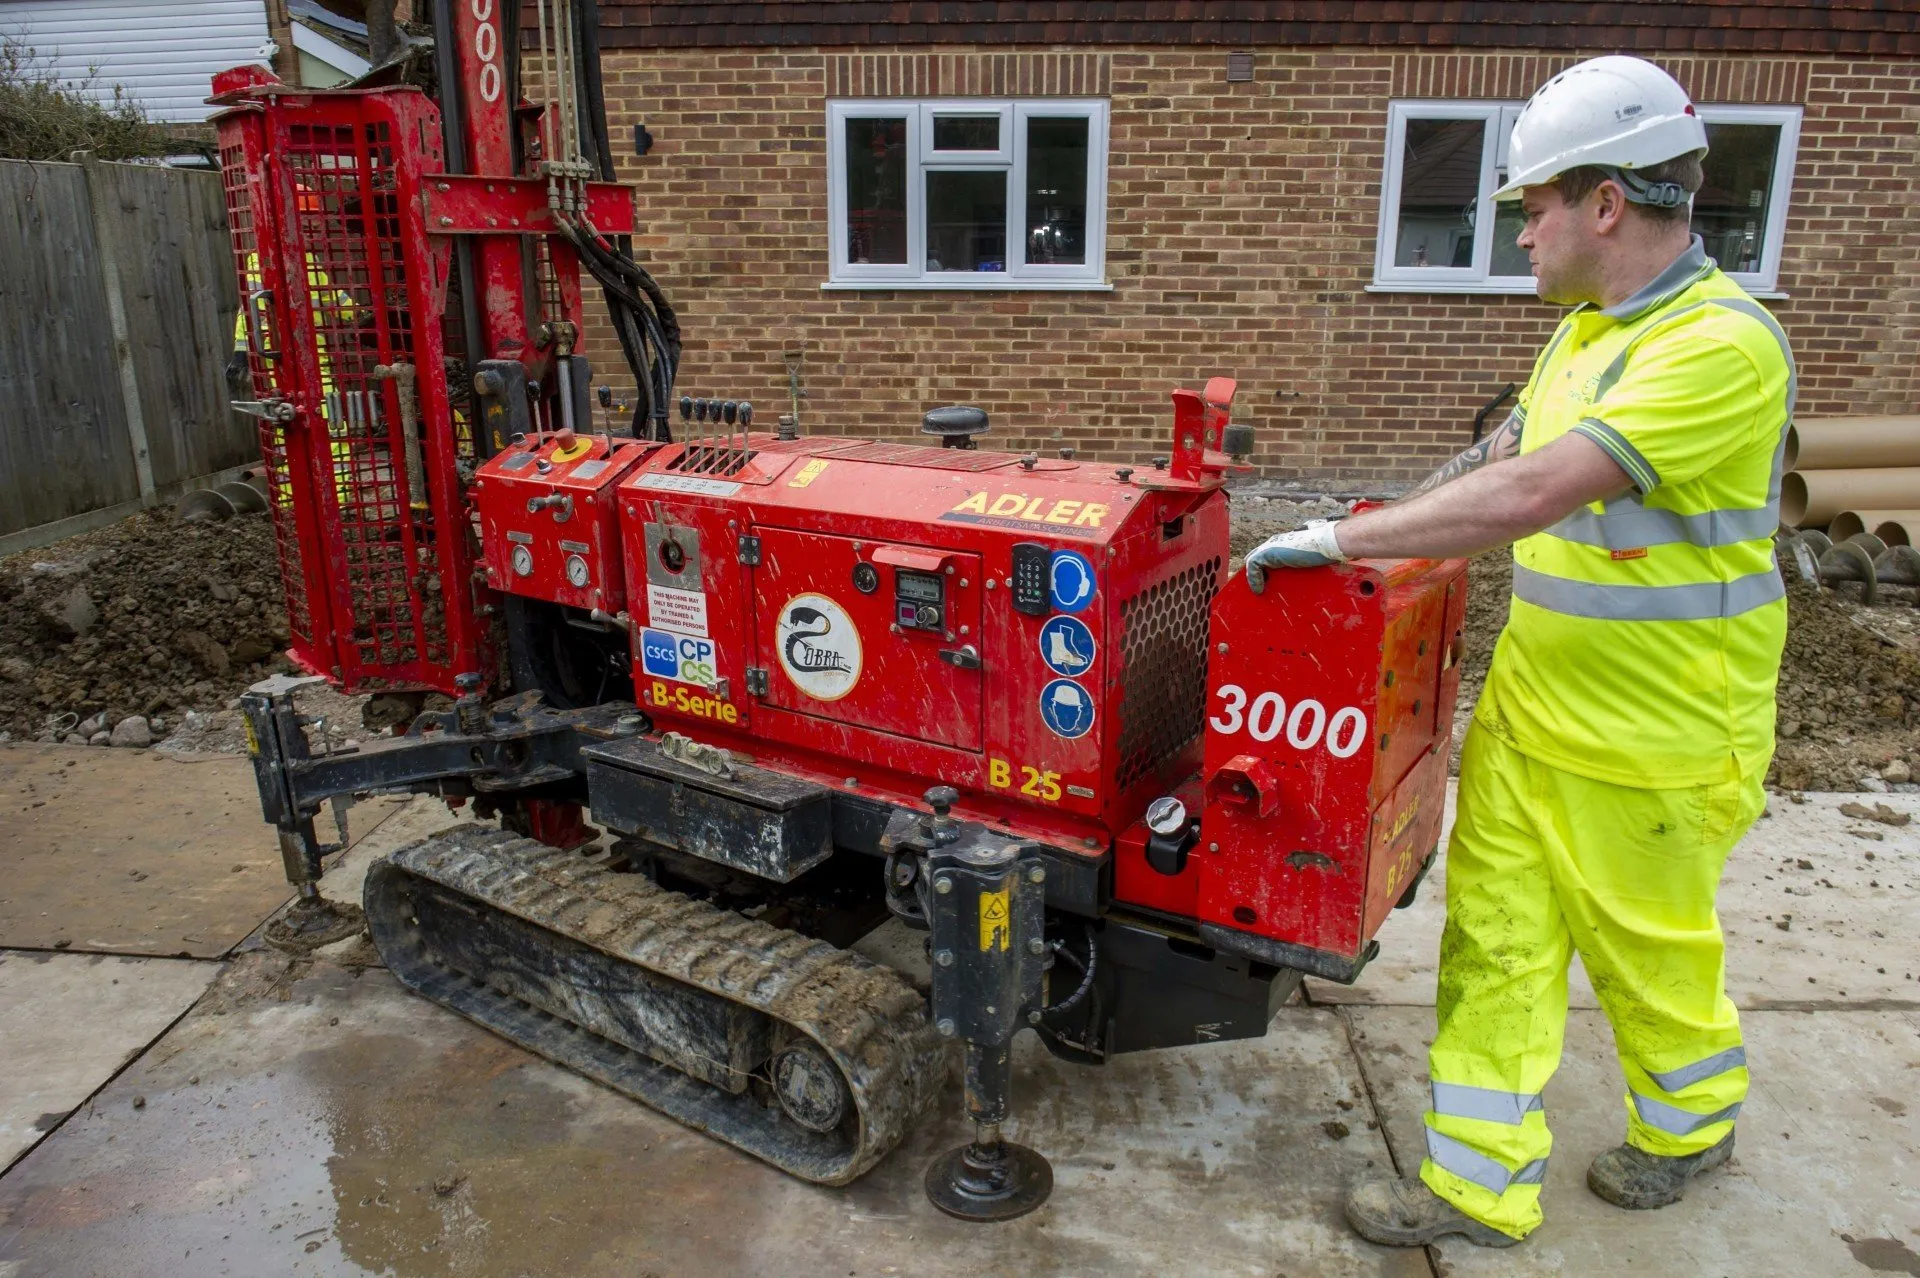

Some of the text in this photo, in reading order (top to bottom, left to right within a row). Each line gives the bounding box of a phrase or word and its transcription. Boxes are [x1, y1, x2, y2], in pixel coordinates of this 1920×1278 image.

[952, 491, 1112, 528] ADLER
[975, 517, 1096, 538] ARBEITSMASCHINEN
[665, 593, 687, 602] MACHINE
[674, 603, 700, 613] OPERATED
[651, 616, 706, 631] AUTHORISED PERSONS
[668, 610, 690, 619] TRAINED
[646, 645, 676, 663] CSCS
[679, 638, 711, 662] CP
[680, 660, 714, 685] CS
[652, 681, 738, 724] B-Serie
[1209, 684, 1368, 759] 3000
[989, 757, 1011, 788] B
[1020, 765, 1062, 801] 25
[1391, 794, 1420, 842] ADLER
[1386, 840, 1414, 899] B 25
